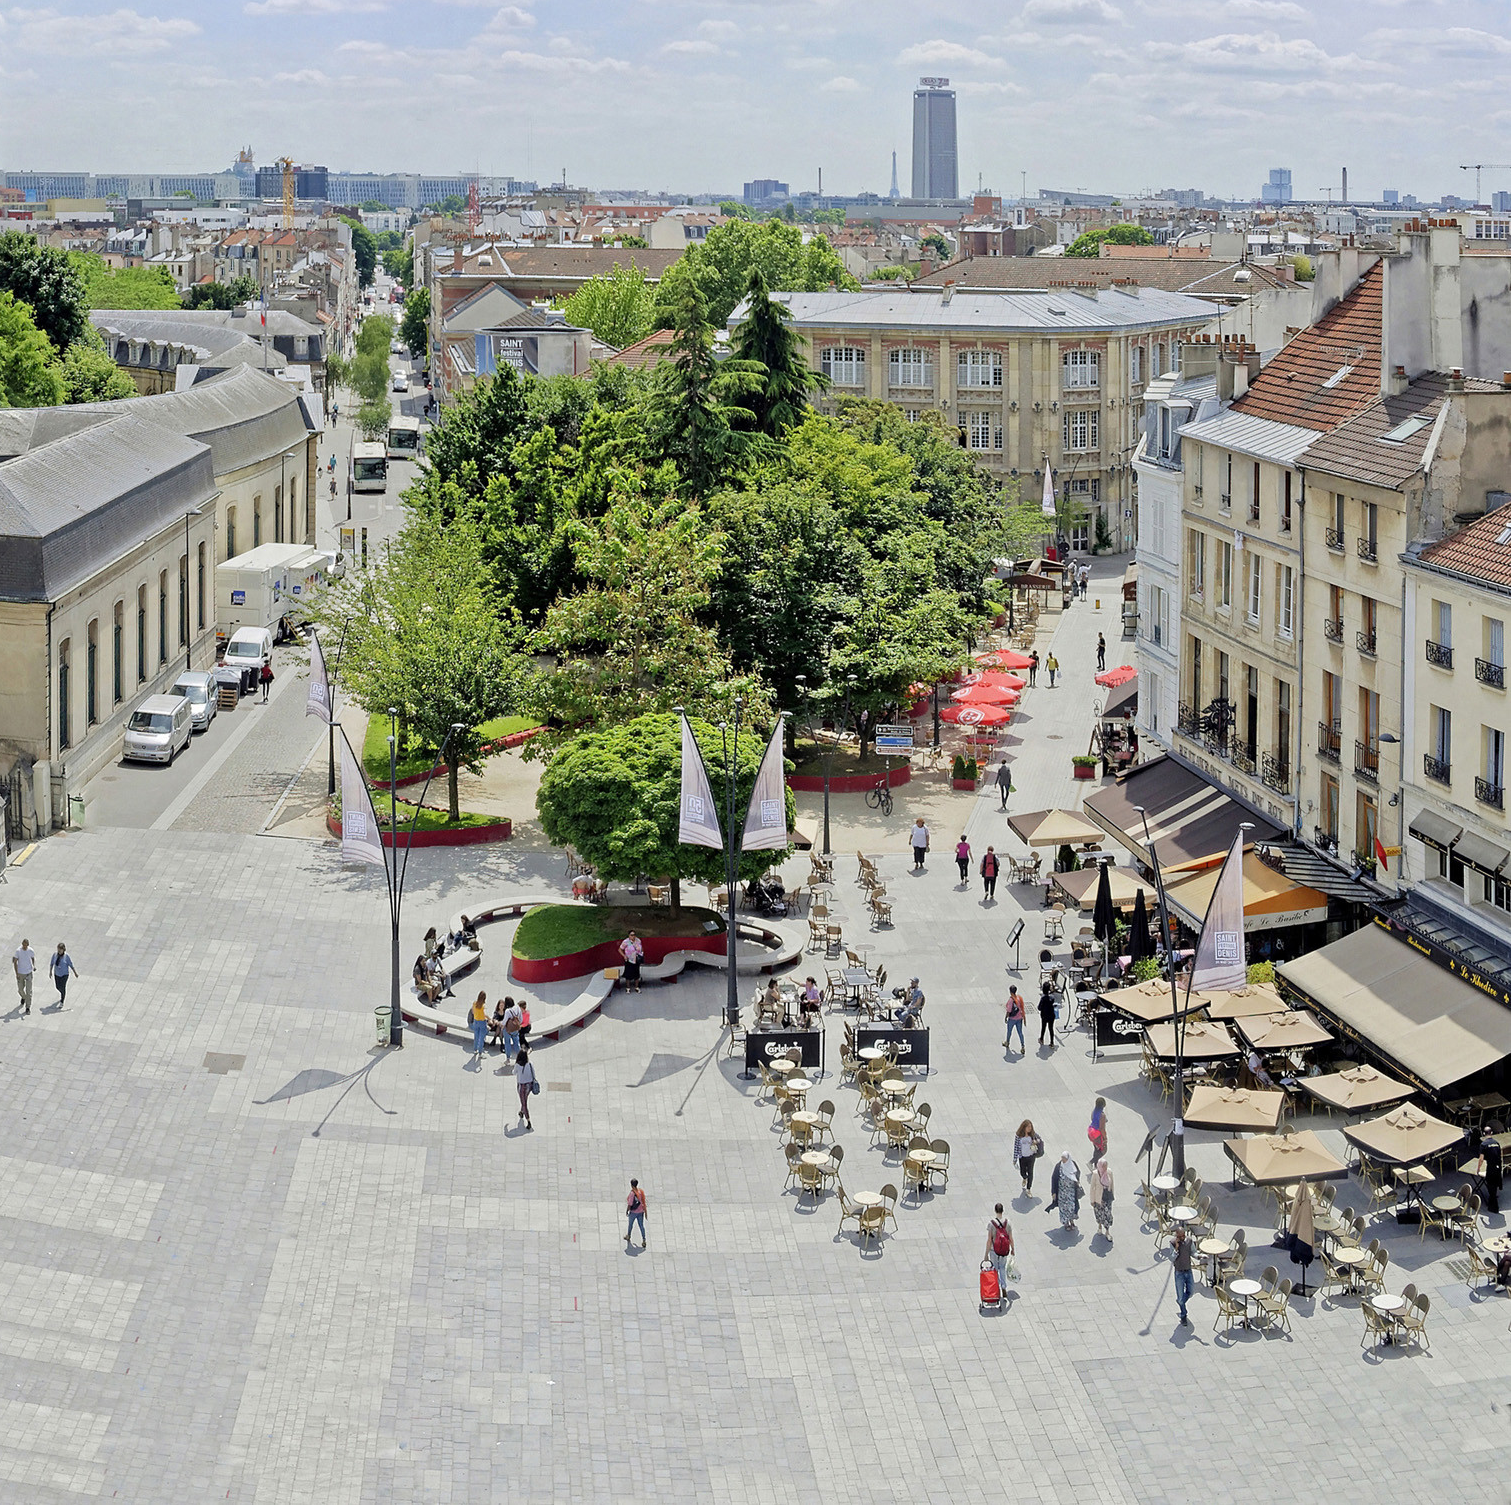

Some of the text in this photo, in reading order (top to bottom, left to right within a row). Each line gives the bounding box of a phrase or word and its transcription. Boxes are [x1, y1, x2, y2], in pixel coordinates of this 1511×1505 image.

[39, 178, 55, 186] SFR
[500, 339, 523, 348] SAINT
[500, 349, 523, 357] festival
[1217, 934, 1236, 942] SAINT
[1218, 949, 1237, 957] DENIS
[1460, 964, 1469, 980] Le
